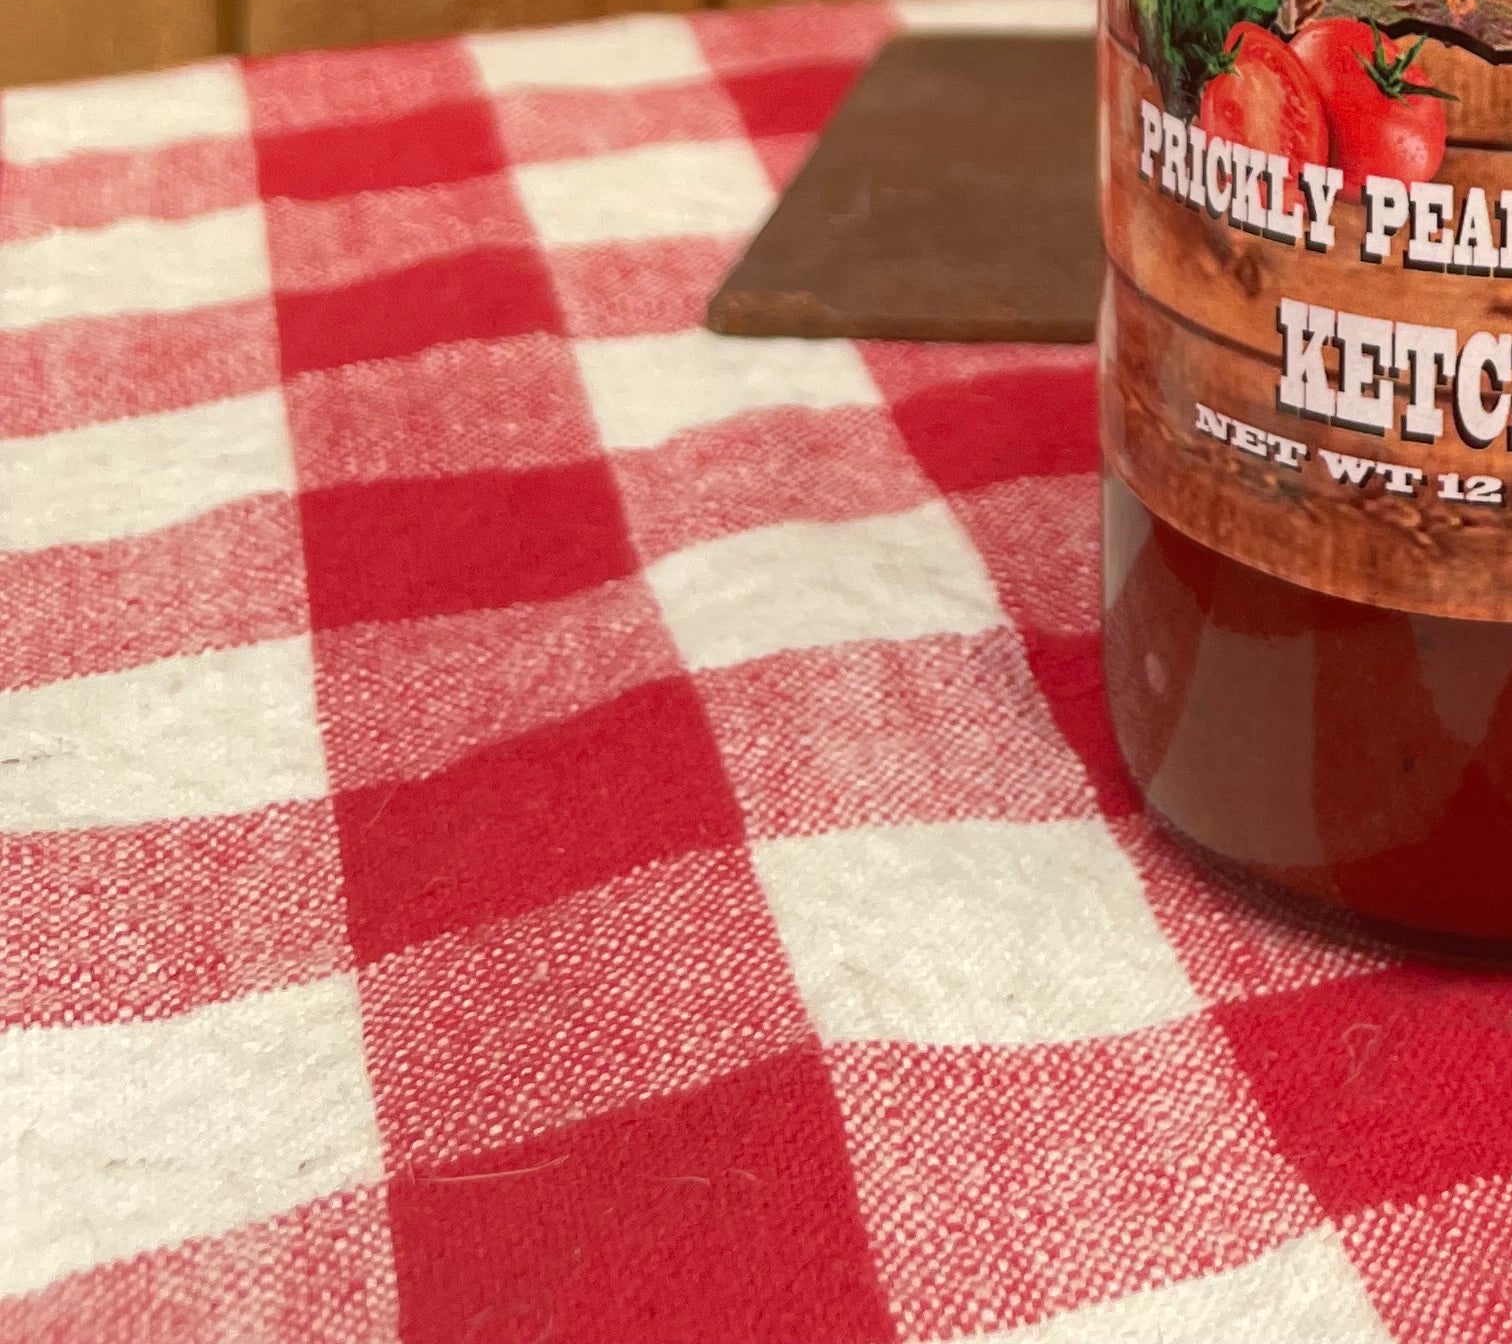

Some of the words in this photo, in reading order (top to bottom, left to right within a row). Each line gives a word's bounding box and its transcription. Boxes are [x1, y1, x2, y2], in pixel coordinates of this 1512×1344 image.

[1138, 100, 1344, 250] PRICKLY
[1195, 403, 1307, 468] NET
[1317, 450, 1424, 498] WT
[1436, 472, 1505, 505] 12
